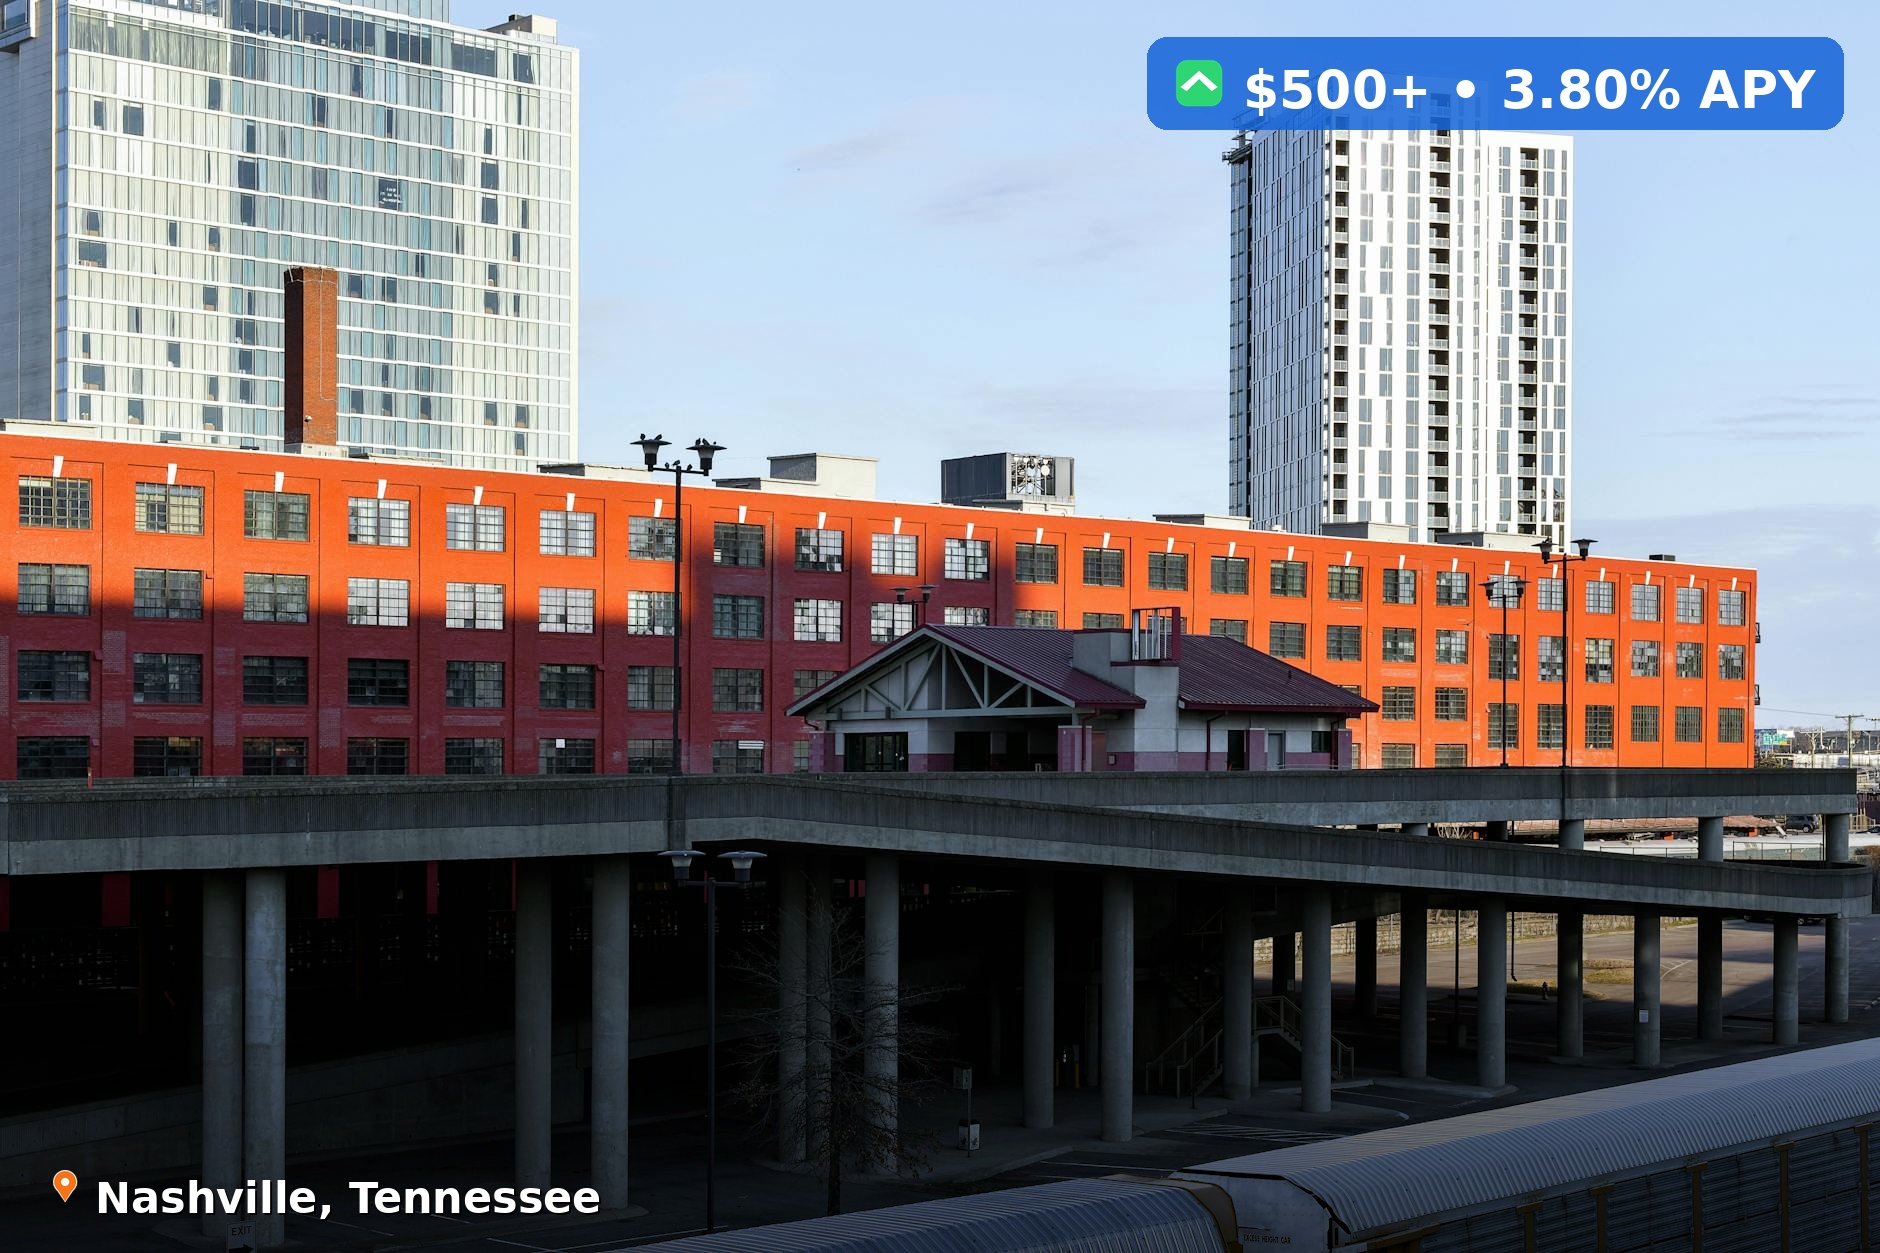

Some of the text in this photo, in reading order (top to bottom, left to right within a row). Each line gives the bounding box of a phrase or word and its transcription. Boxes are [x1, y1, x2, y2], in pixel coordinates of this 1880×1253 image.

[231, 1225, 252, 1236] EXIT
[1243, 1234, 1291, 1244] EXCESS HEIGHT CAR
